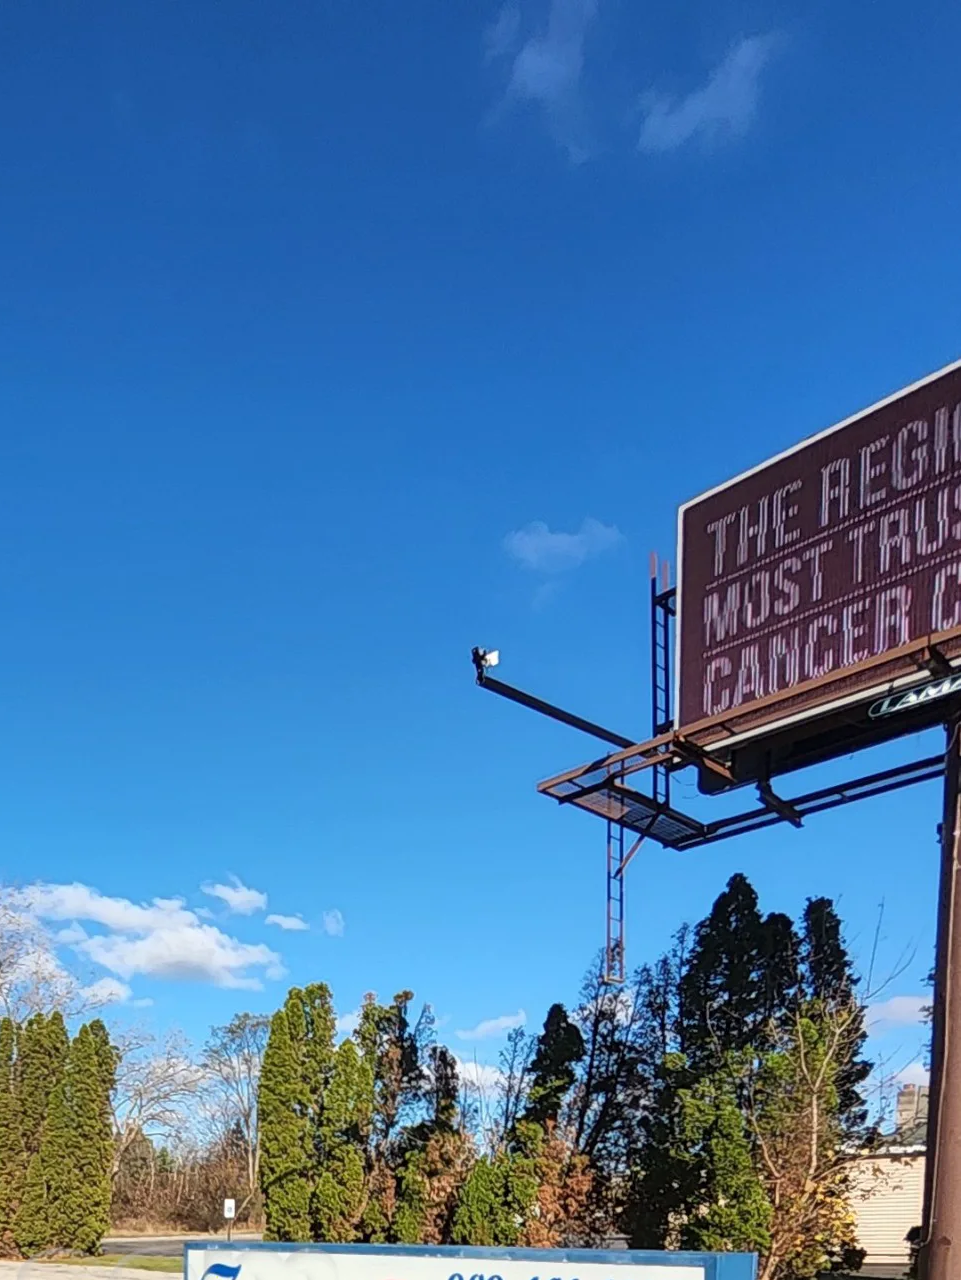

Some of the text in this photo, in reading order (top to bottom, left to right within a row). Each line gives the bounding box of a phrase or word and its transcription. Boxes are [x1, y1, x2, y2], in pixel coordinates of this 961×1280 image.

[706, 402, 961, 577] THE REGI
[703, 539, 834, 647] MOST
[703, 584, 912, 717] CANCER
